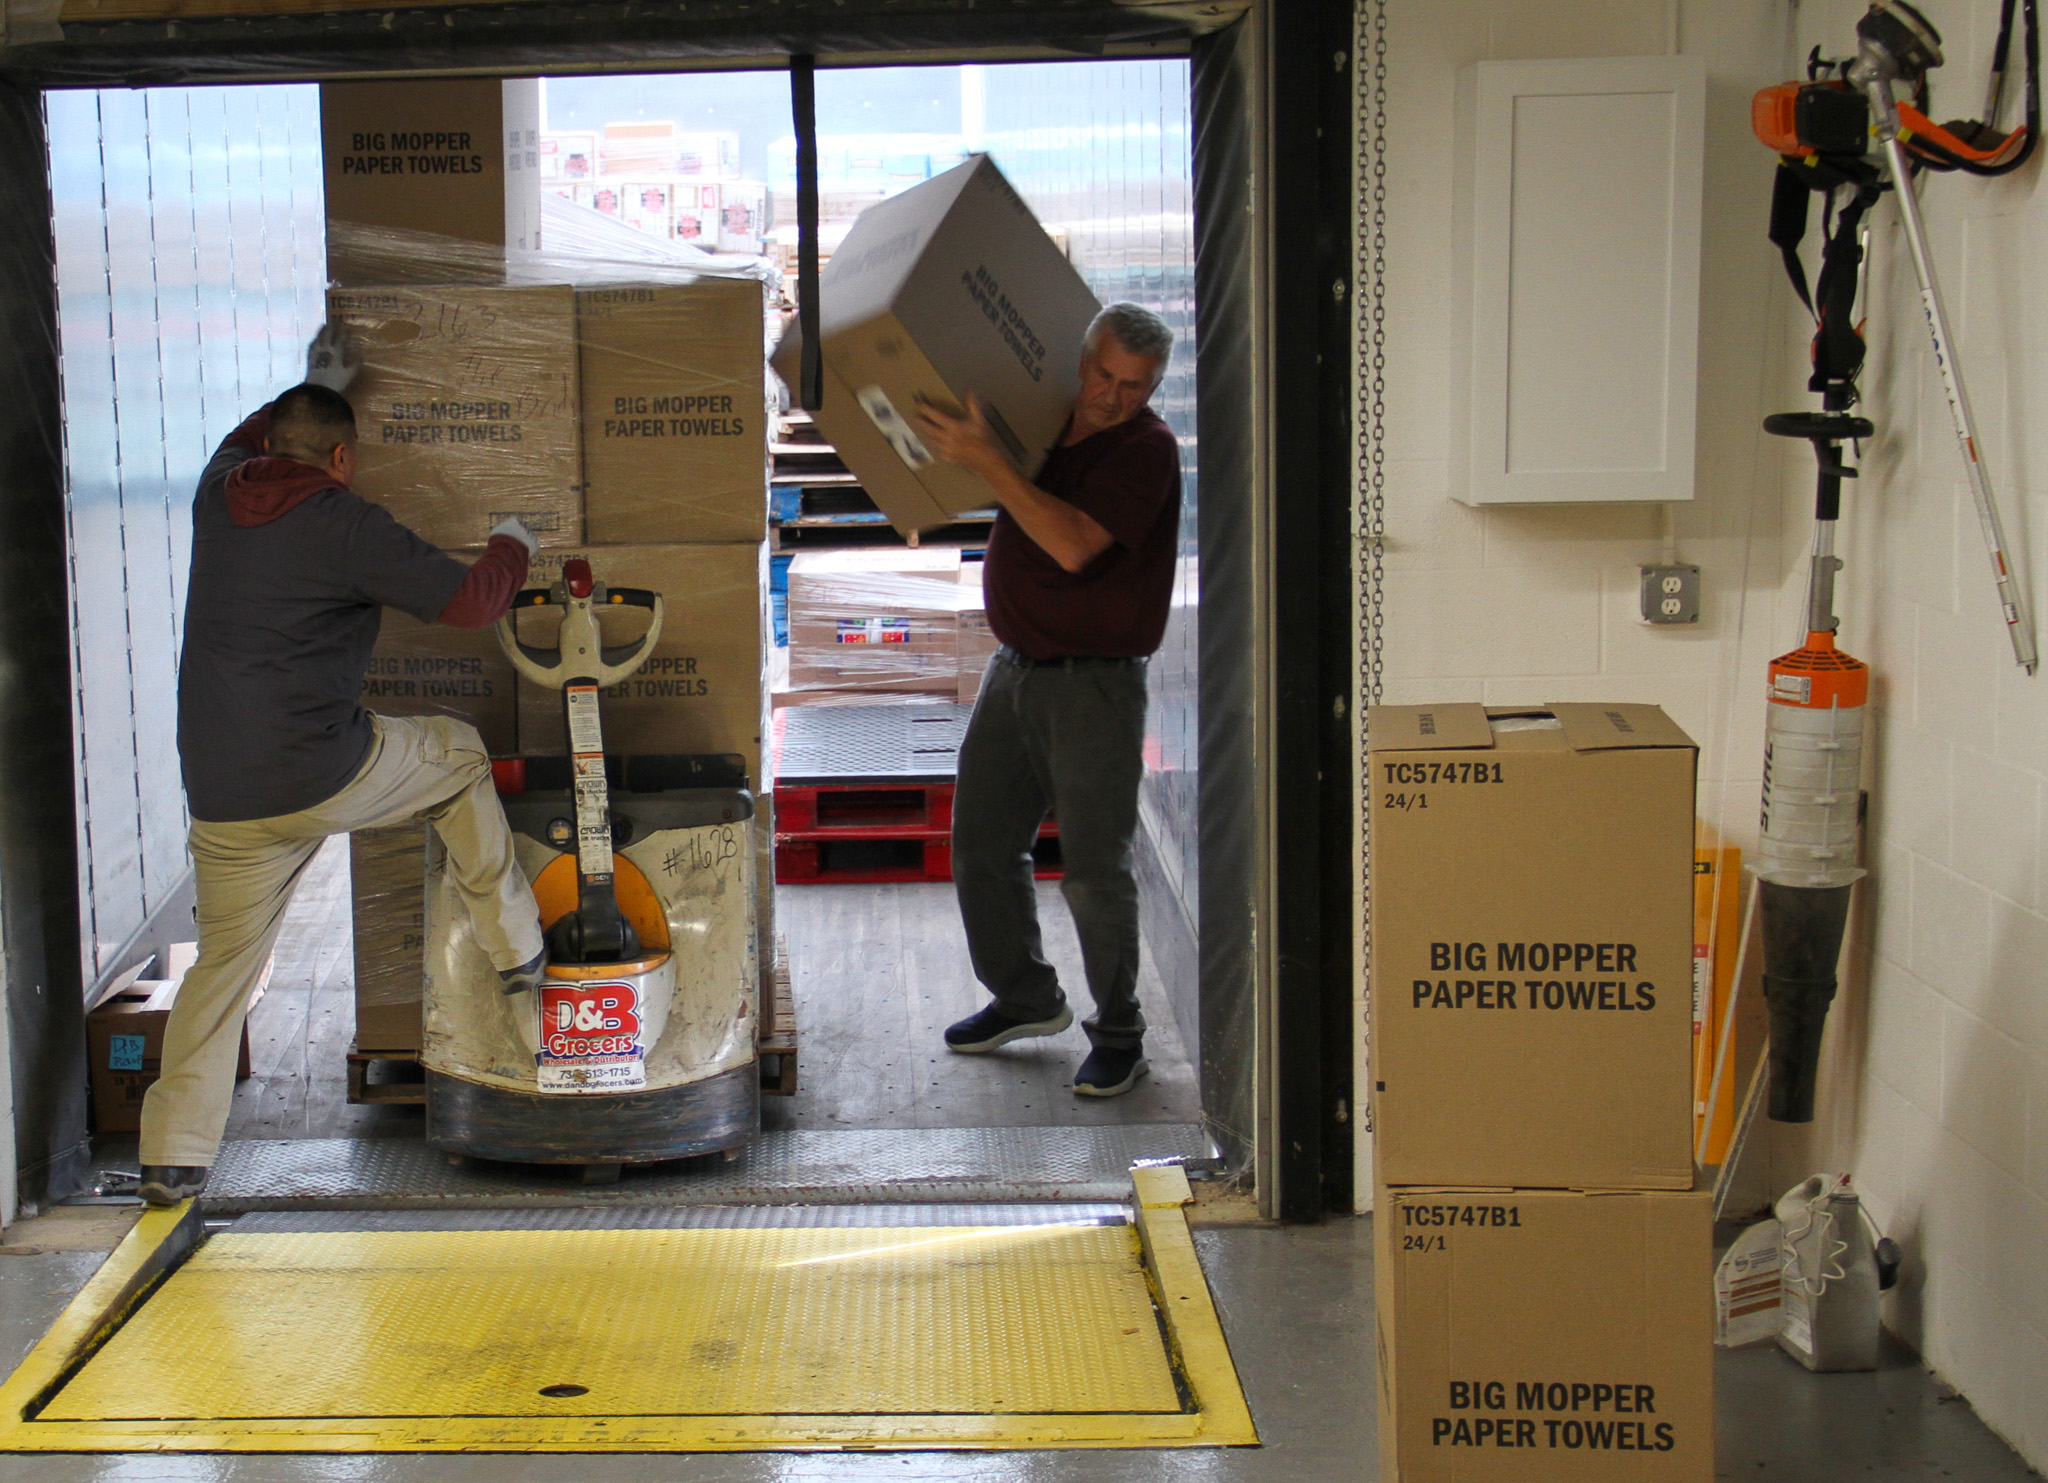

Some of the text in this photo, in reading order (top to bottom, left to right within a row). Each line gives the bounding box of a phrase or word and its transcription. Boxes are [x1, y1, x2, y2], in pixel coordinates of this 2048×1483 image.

[352, 133, 472, 151] BIG MOPPER
[343, 155, 483, 174] PAPER TOWELS
[976, 264, 1046, 361] BIG MOPPER
[960, 269, 1044, 383] PAPER TOWELS
[391, 402, 512, 420] BIG MOPPER
[615, 396, 733, 415] BIG MOPPER
[382, 424, 523, 443] PAPER TOWELS
[604, 419, 744, 438] PAPER TOWELS
[367, 656, 483, 675] BIG MOPPER
[421, 679, 493, 697] TOWELS
[634, 679, 708, 697] TOWELS
[1383, 762, 1504, 784] TC5747B1
[1760, 742, 1773, 833] STIHL
[1384, 793, 1428, 812] 24/1
[1430, 942, 1637, 973] BIG MOPPER
[1412, 980, 1656, 1011] PAPER TOWELS
[538, 982, 641, 1041] D&B
[548, 1033, 634, 1057] Grocers
[543, 1057, 583, 1066] Wholesale
[585, 1057, 592, 1065] &
[1402, 1205, 1522, 1228] TC5747B1
[1403, 1236, 1446, 1254] 24/1
[1449, 1381, 1656, 1414] BIG MOPPER
[1432, 1418, 1675, 1452] PAPER TOWELS
